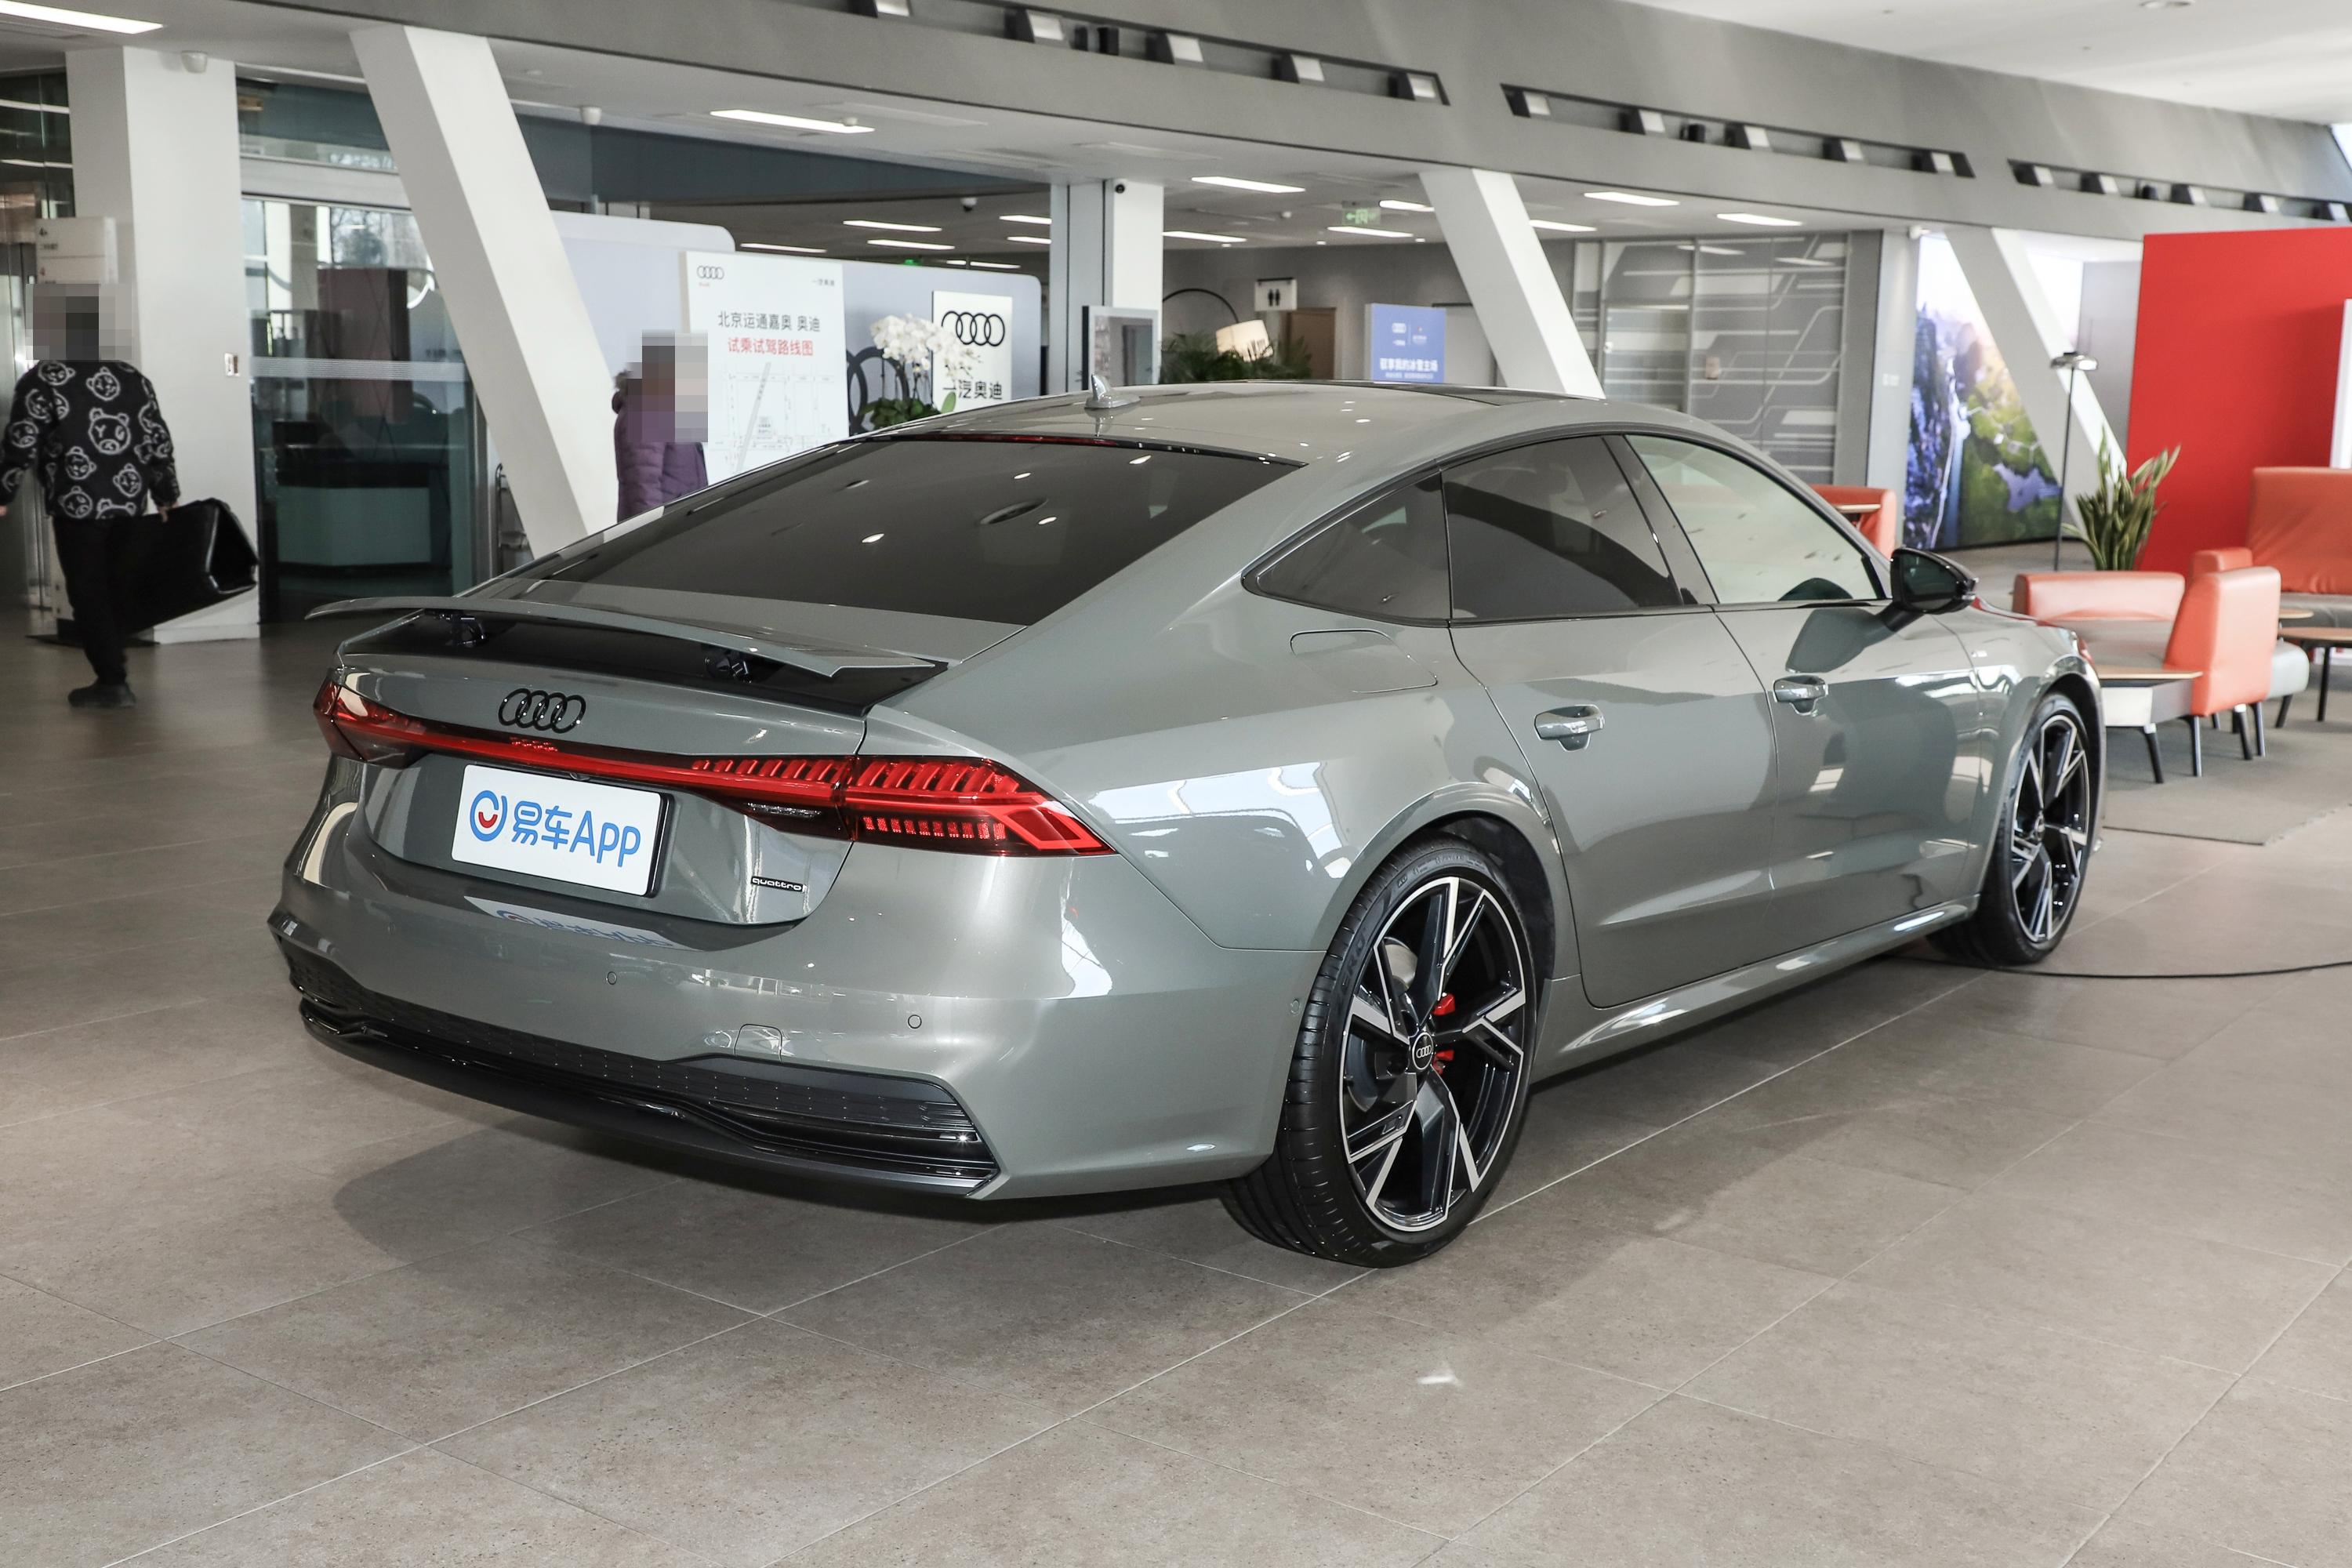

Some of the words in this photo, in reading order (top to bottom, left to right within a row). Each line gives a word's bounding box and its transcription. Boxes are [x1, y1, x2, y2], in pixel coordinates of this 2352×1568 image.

[717, 311, 792, 331] 北京运通嘉奥
[797, 315, 821, 332] 奥迪
[728, 337, 814, 356] 试乘试驾路线图
[943, 379, 1003, 400] 一汽奥迪
[511, 800, 641, 867] 易车App
[752, 877, 802, 891] quattro
